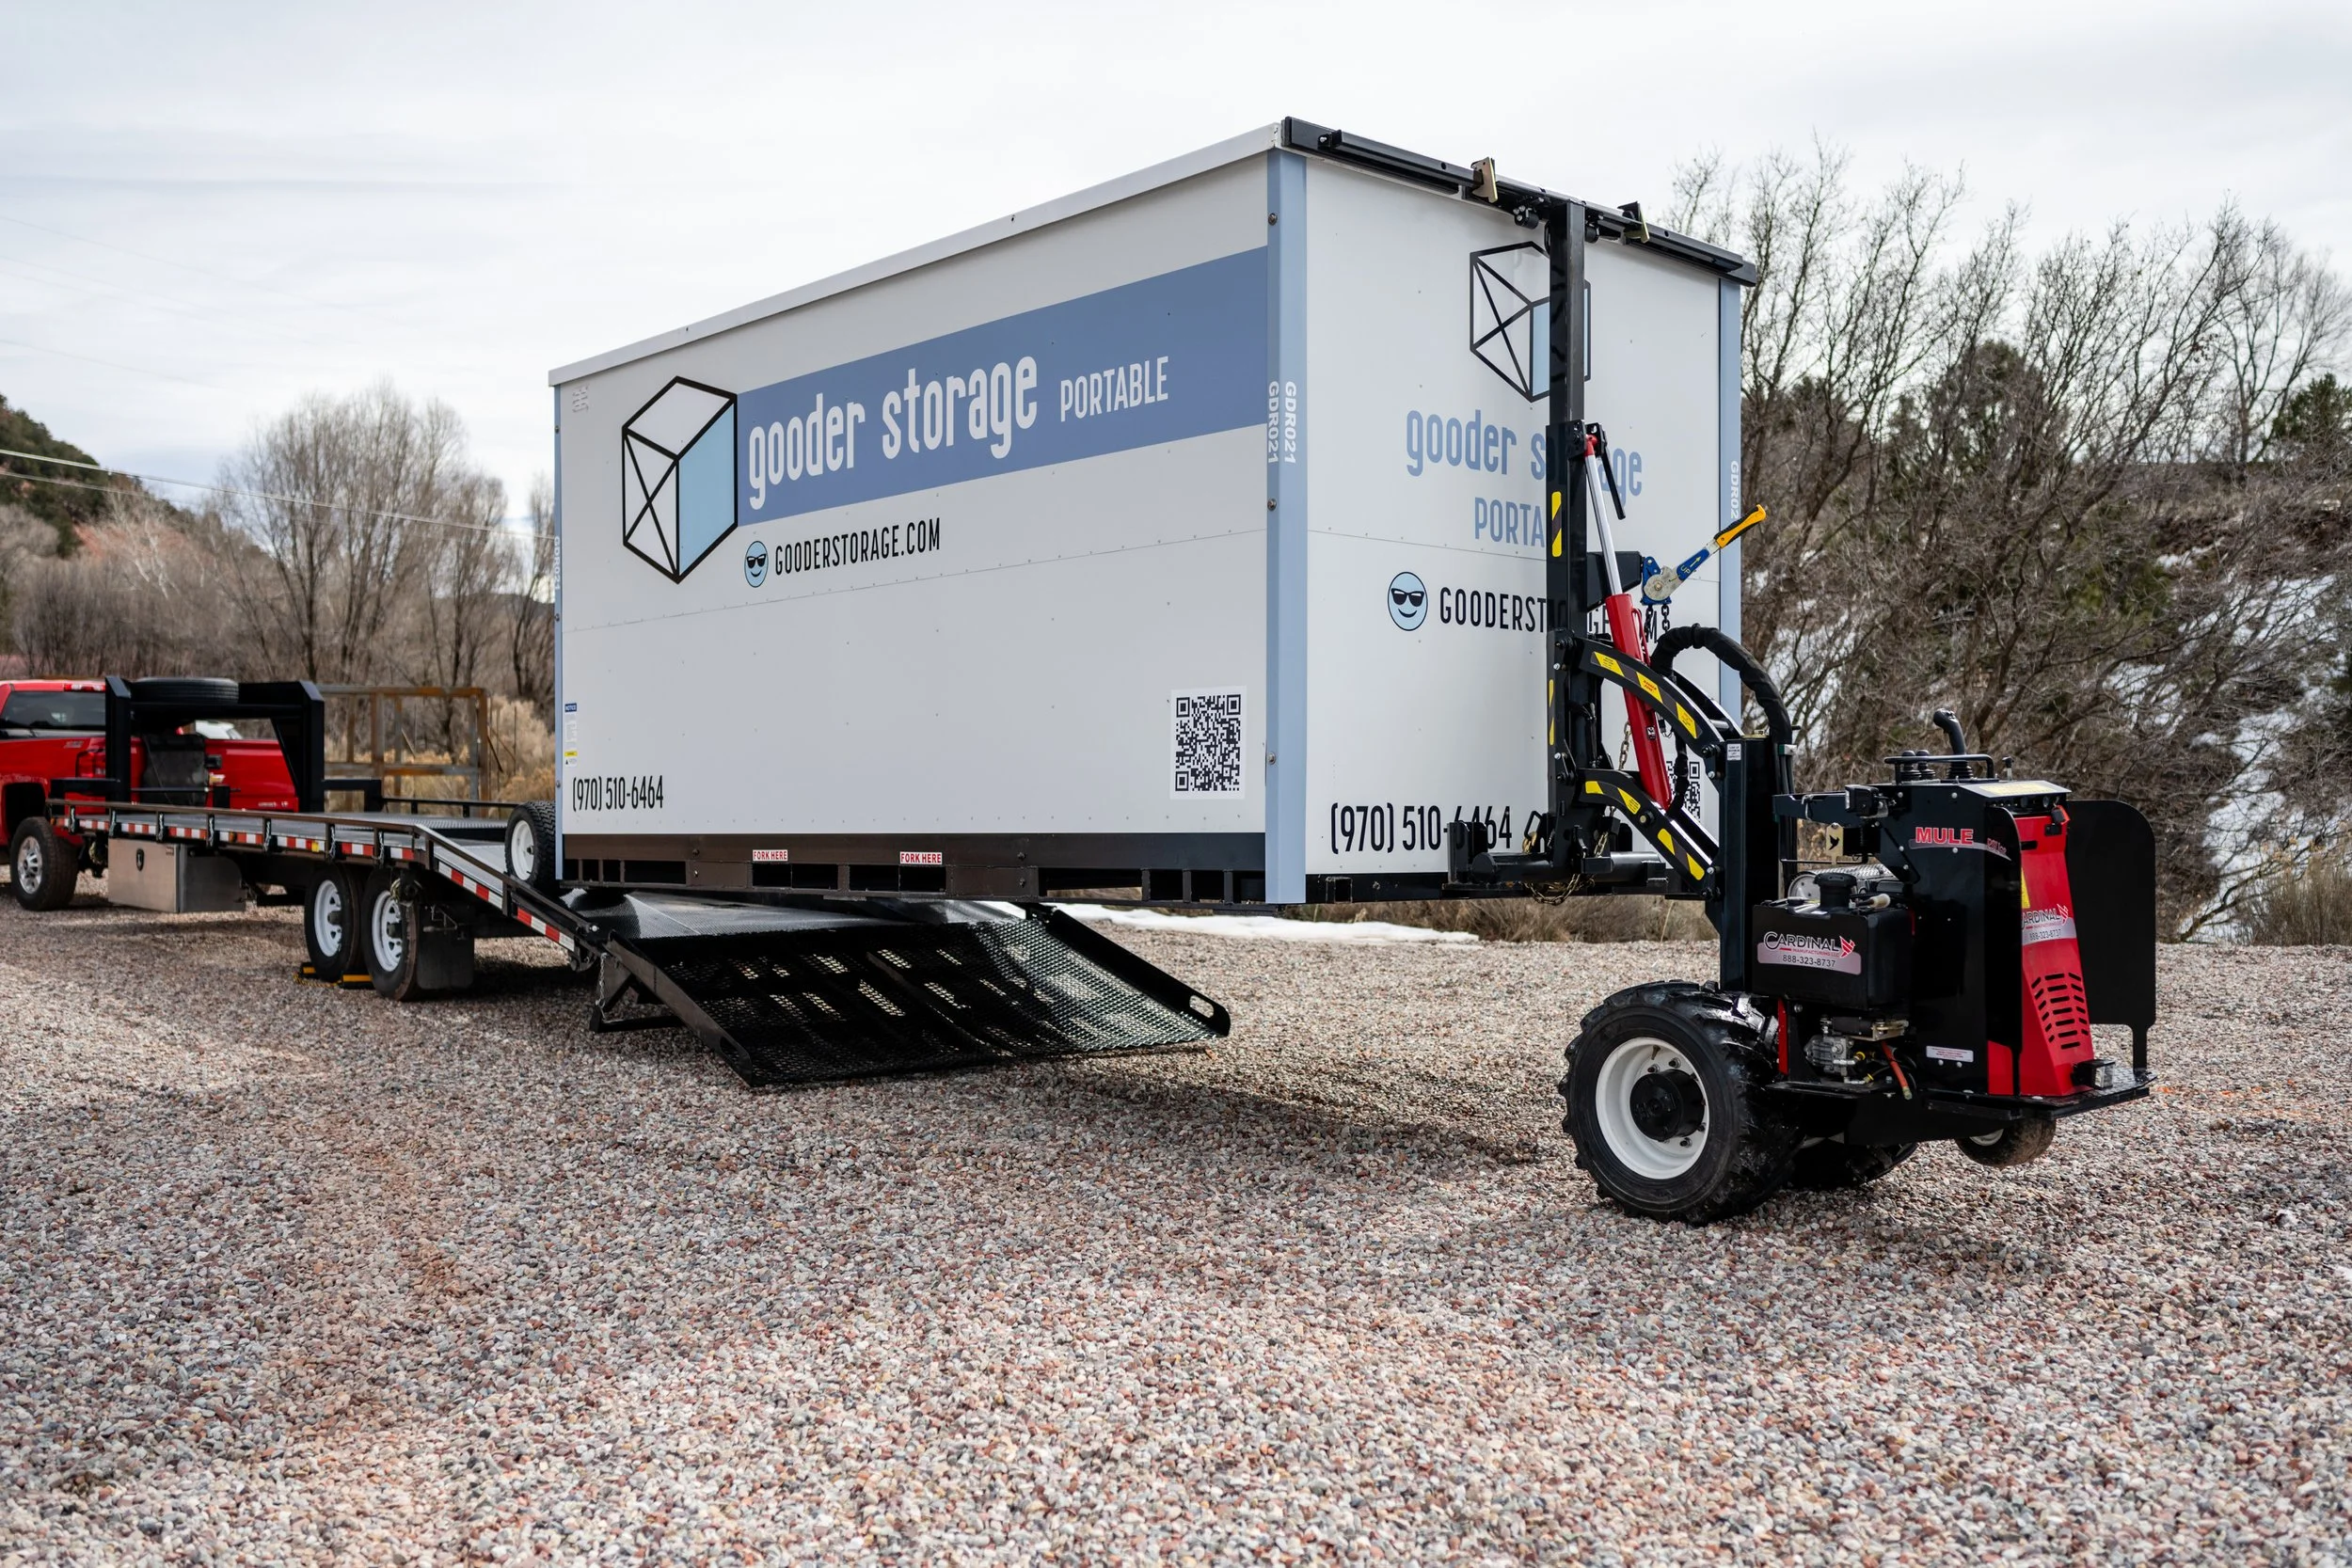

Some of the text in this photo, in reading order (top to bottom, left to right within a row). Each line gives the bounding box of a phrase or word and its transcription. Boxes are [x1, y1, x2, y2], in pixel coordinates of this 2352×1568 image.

[749, 356, 1168, 510] gooder storage PORTABLE
[1267, 381, 1279, 463] GDR021
[1284, 381, 1296, 464] GDR021
[1406, 409, 1517, 477] gooder
[1730, 460, 1740, 519] GDR02
[775, 517, 940, 576] GOODERSTORAGE.COM
[1474, 497, 1546, 547] PORTA
[1680, 564, 1692, 575] UP
[573, 775, 664, 812] (970) 510-6464
[1330, 802, 1394, 854] (970)
[1915, 827, 1974, 845] MULE
[754, 850, 787, 860] FORK HERE
[900, 853, 942, 863] FORK HERE
[1764, 931, 1839, 952] CARDINAL
[1782, 954, 1836, 967] 888-323-8737
